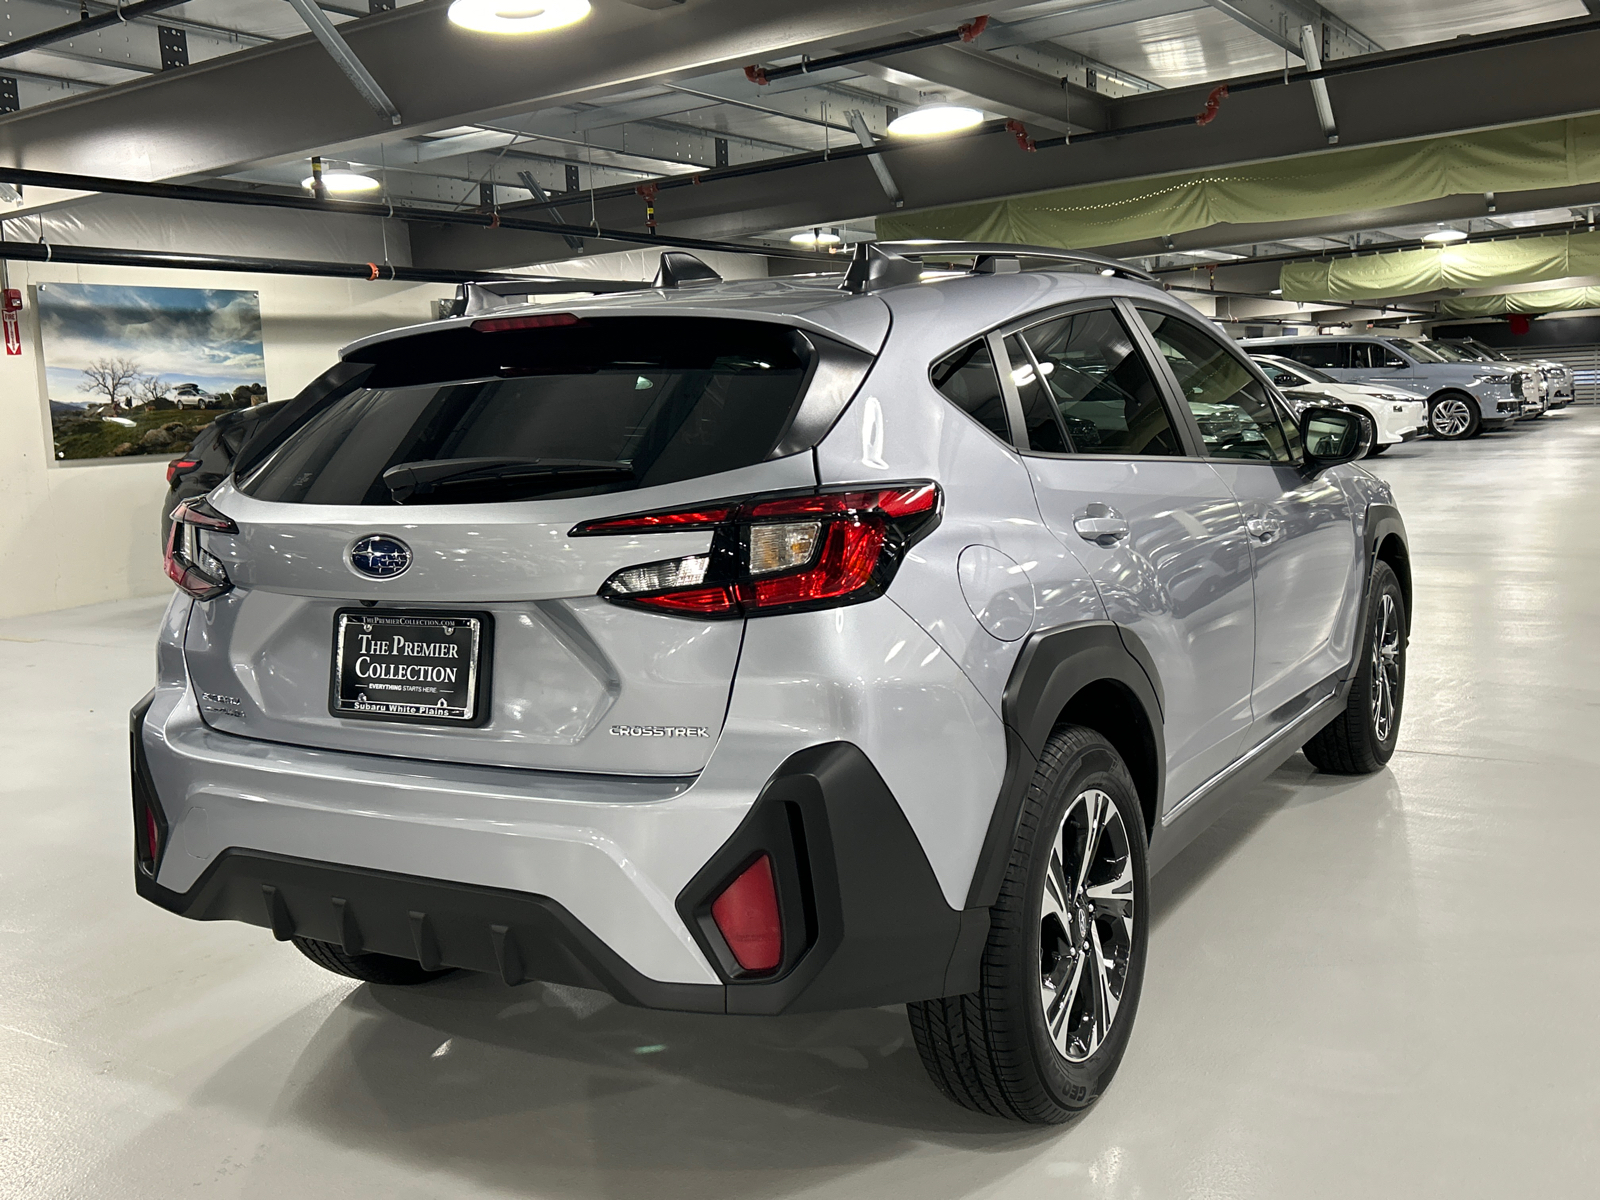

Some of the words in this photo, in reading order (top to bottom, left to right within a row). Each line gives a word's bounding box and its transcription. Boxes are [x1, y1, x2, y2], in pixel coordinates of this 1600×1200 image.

[358, 634, 389, 655] THE
[392, 635, 459, 658] PREMIER
[355, 656, 458, 683] COLLECTION
[369, 683, 402, 691] EVERYTHING
[402, 685, 422, 693] STARTS
[354, 701, 386, 711] Subaru
[388, 704, 417, 714] White
[419, 706, 450, 716] Plains
[609, 725, 710, 738] CROSSTREK
